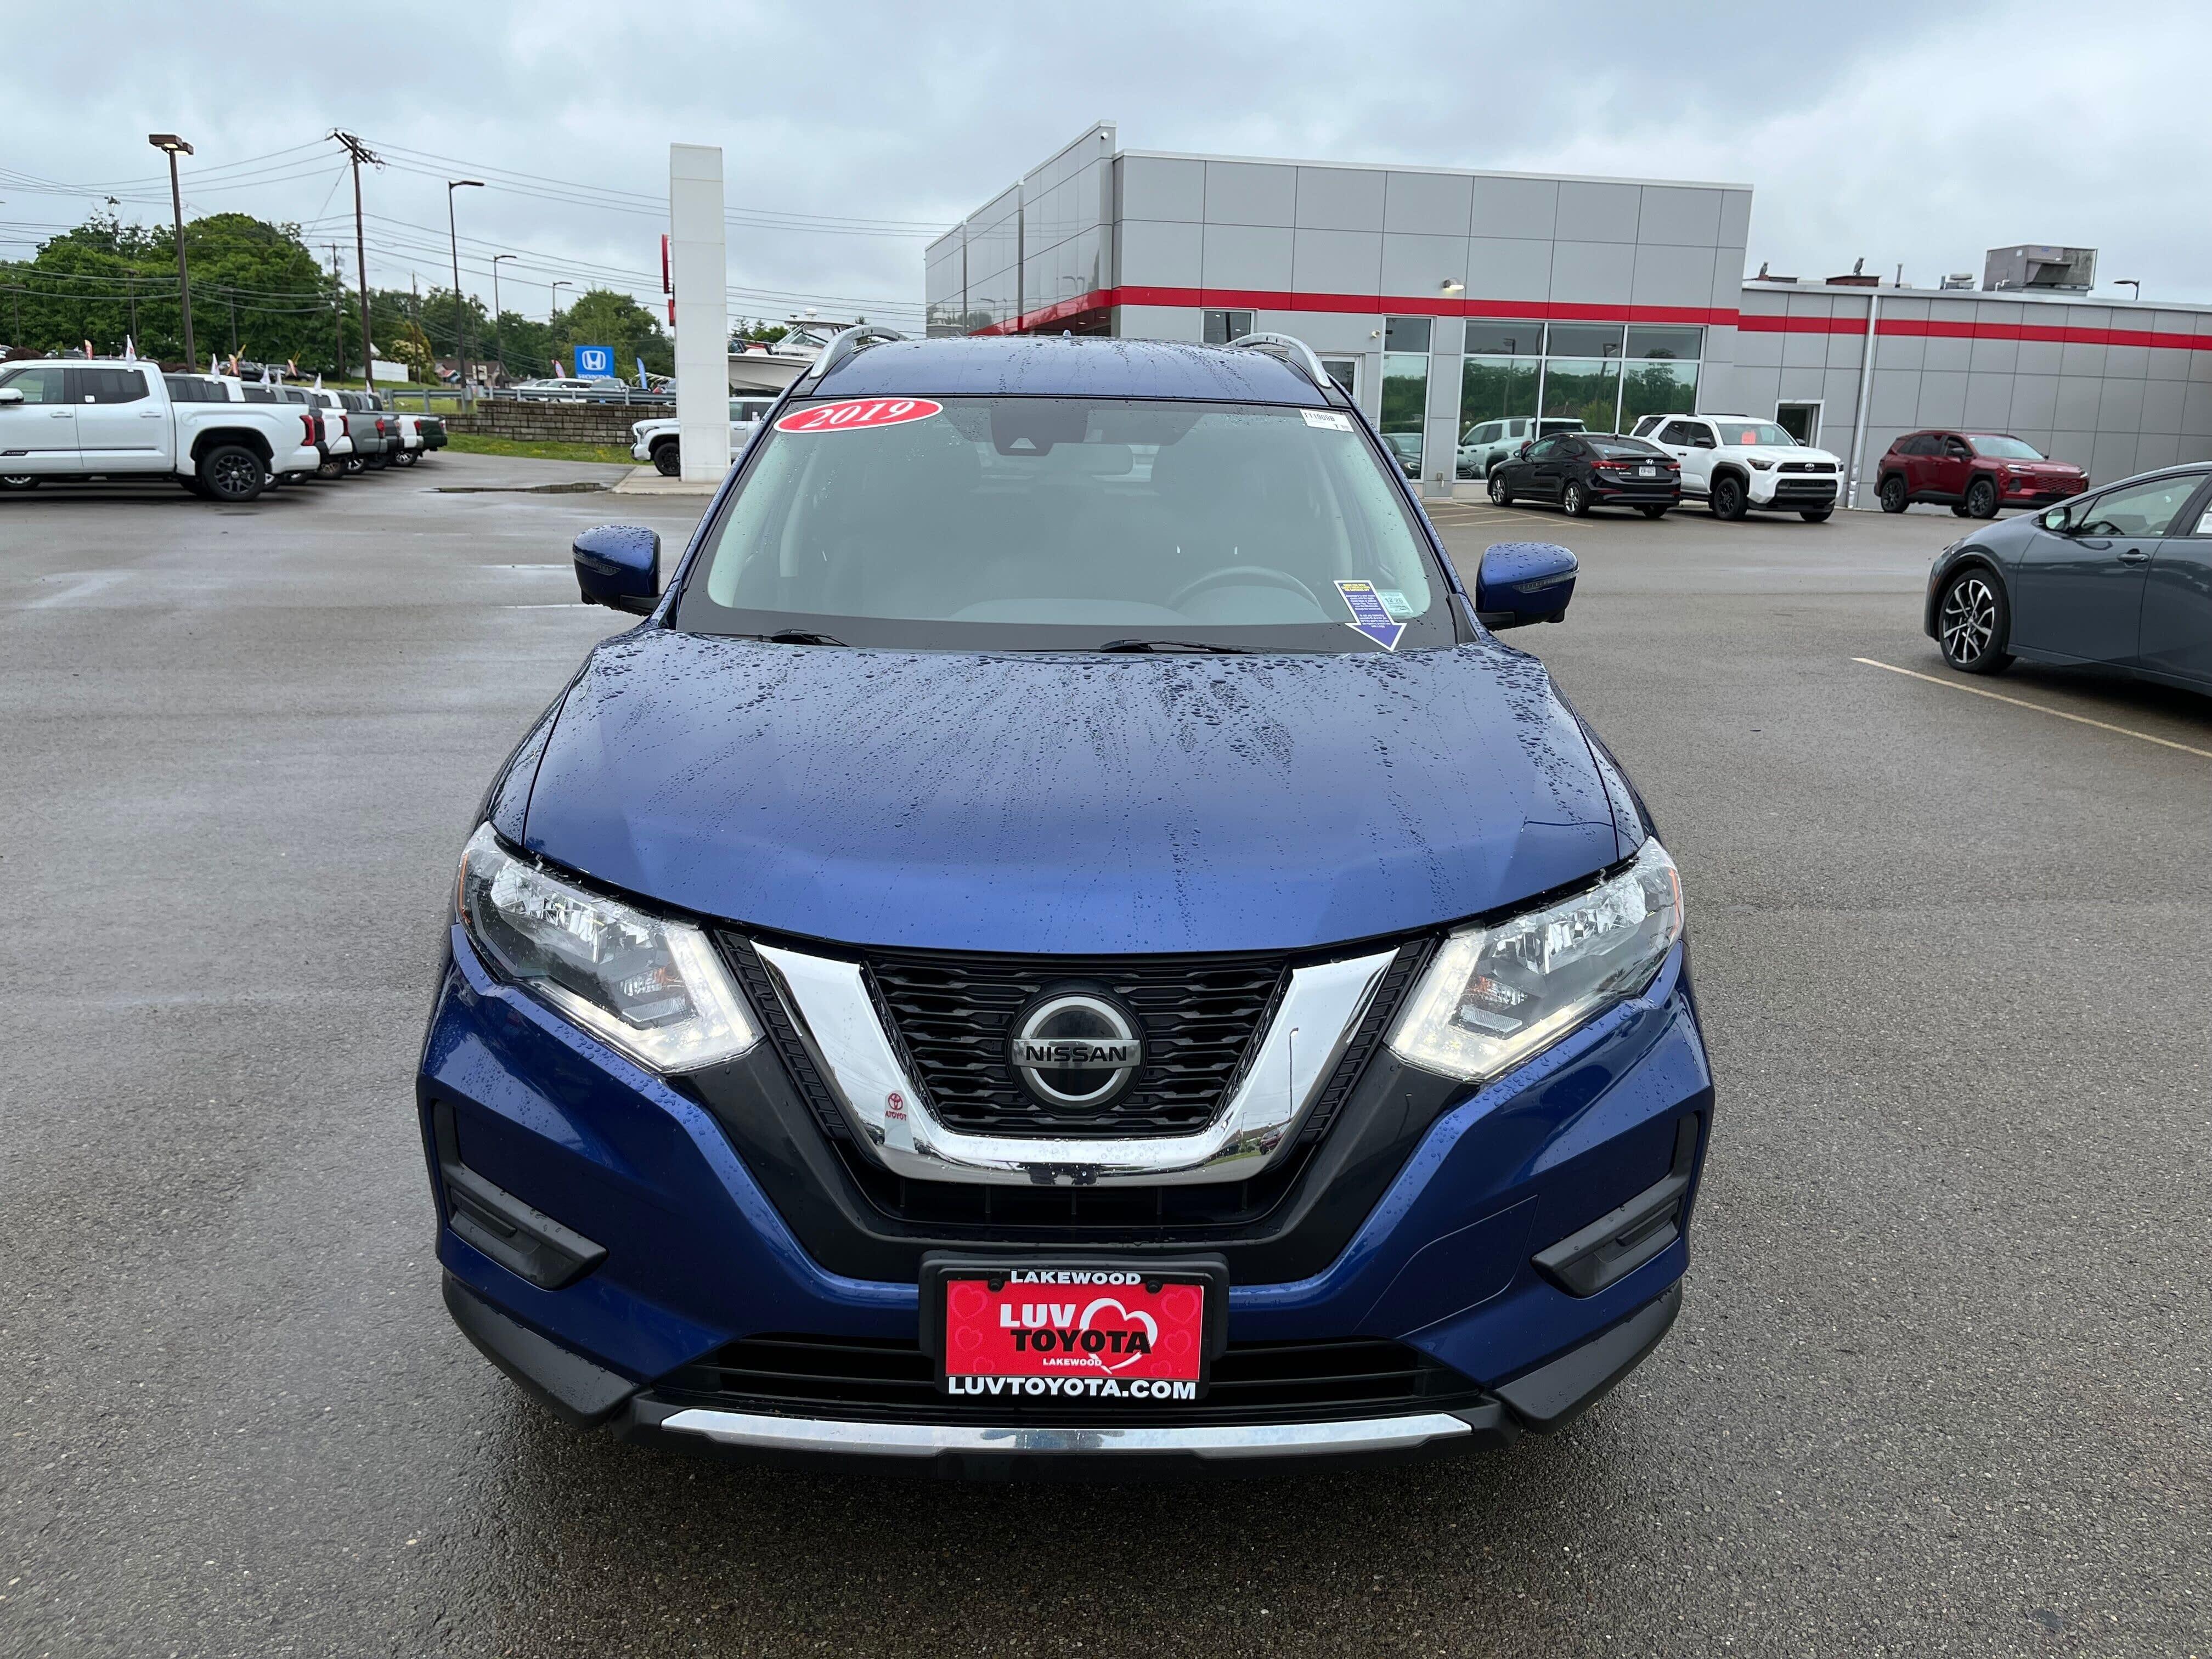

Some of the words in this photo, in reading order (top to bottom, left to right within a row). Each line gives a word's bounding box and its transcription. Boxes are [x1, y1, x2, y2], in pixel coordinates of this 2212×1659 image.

[798, 401, 915, 429] 2019
[1026, 1046, 1127, 1062] NISSAN
[1011, 1271, 1141, 1285] LAKEWOOD
[1000, 1303, 1076, 1328] LUV
[1011, 1328, 1153, 1355] TOYOTA
[1042, 1358, 1102, 1367] LAKEWOOD
[949, 1376, 1195, 1399] LUVTOYOTA.COM
